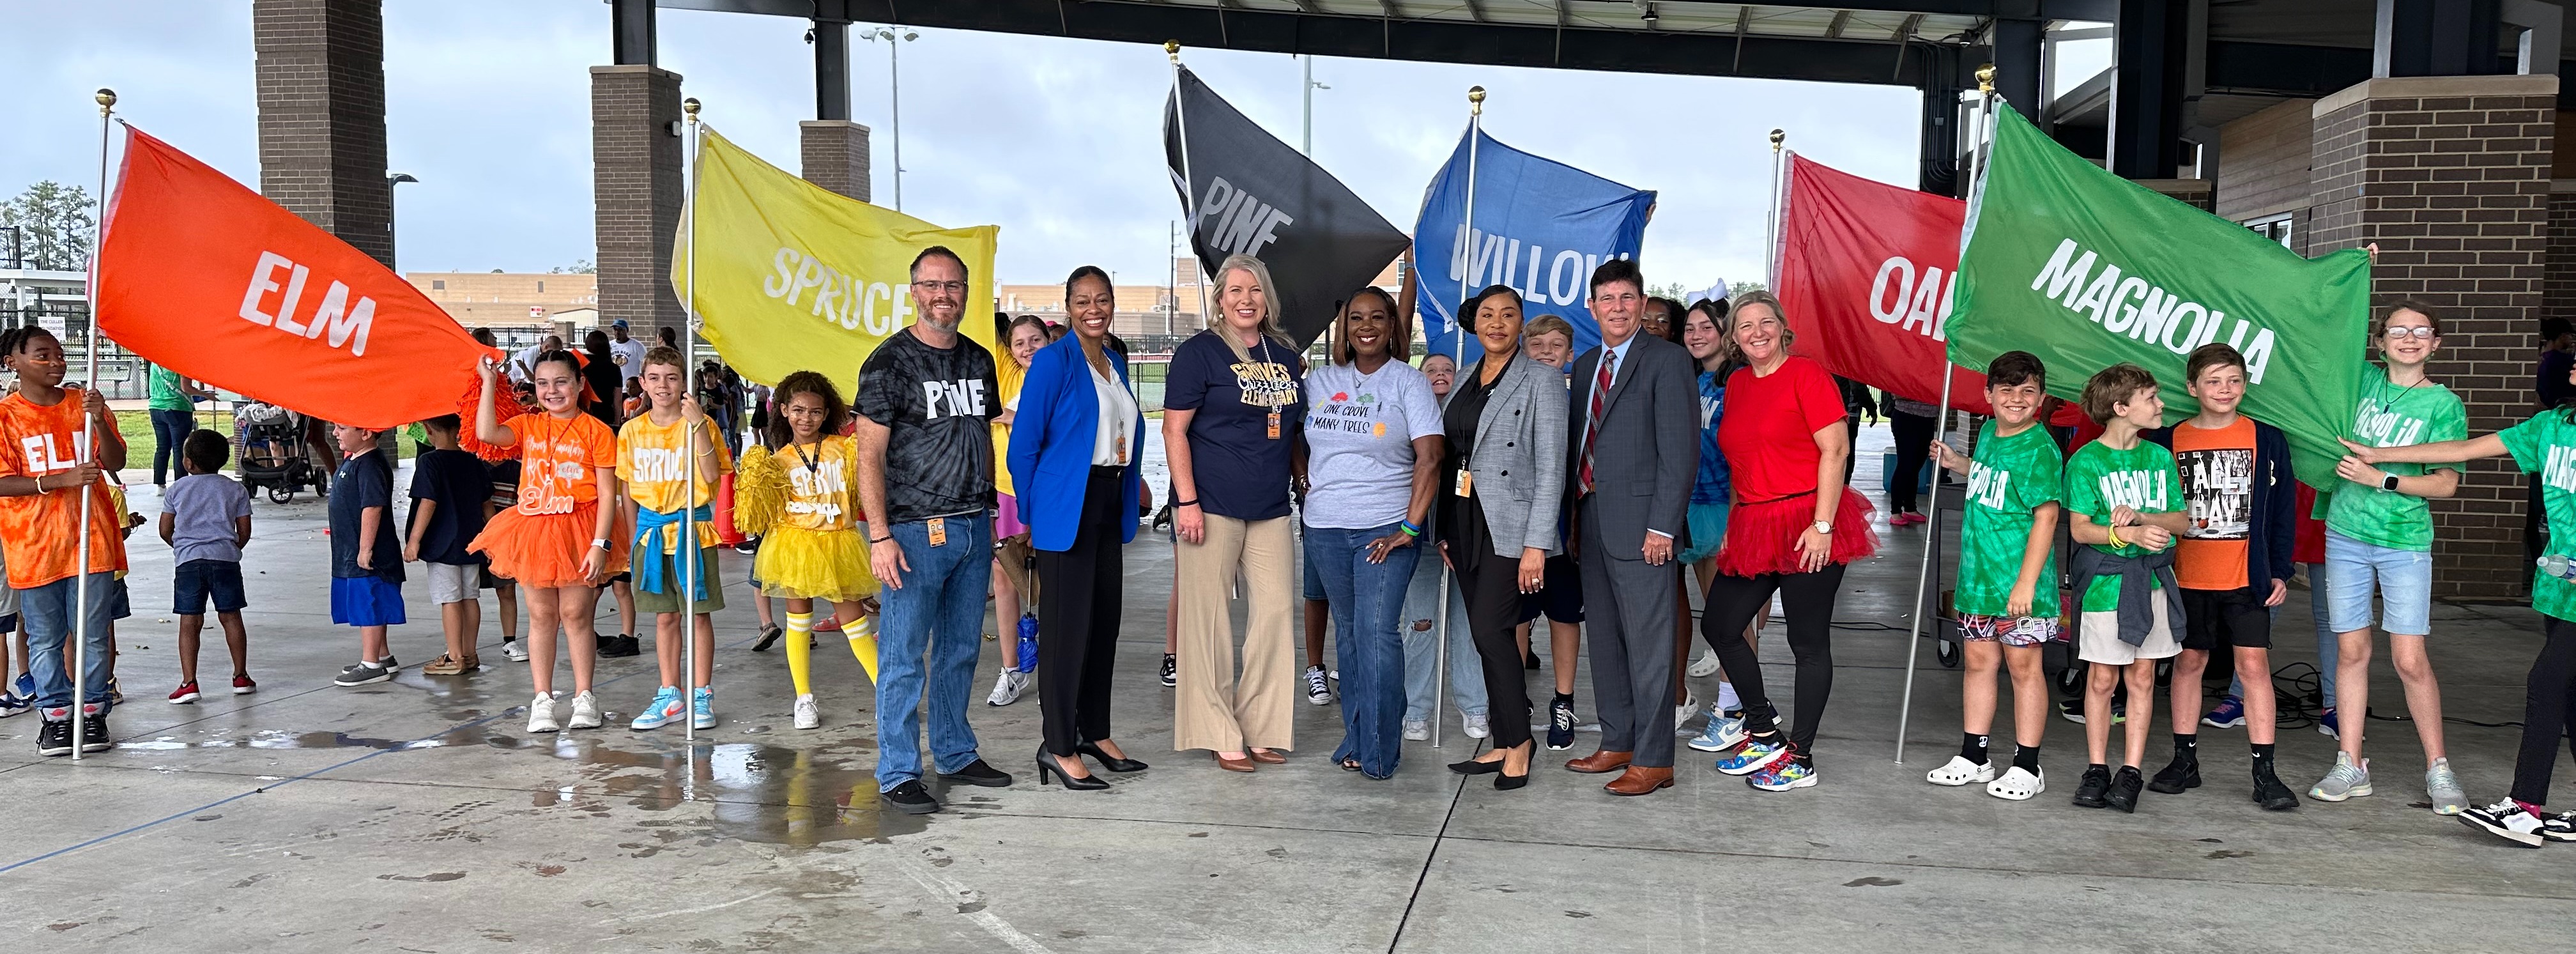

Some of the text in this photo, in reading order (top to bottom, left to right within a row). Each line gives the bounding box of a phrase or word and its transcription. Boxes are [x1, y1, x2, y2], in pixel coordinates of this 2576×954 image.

[1198, 176, 1294, 257] PINE
[239, 250, 376, 357] ELM
[763, 247, 913, 337] SPRUCE
[1230, 362, 1291, 382] GROVES
[923, 379, 985, 419] PiNE
[1324, 404, 1370, 417] ONE GROVE
[1314, 417, 1370, 433] MANY TREES
[790, 458, 846, 496] SPRUC
[2193, 457, 2239, 490] ALL
[518, 484, 574, 516] Elm
